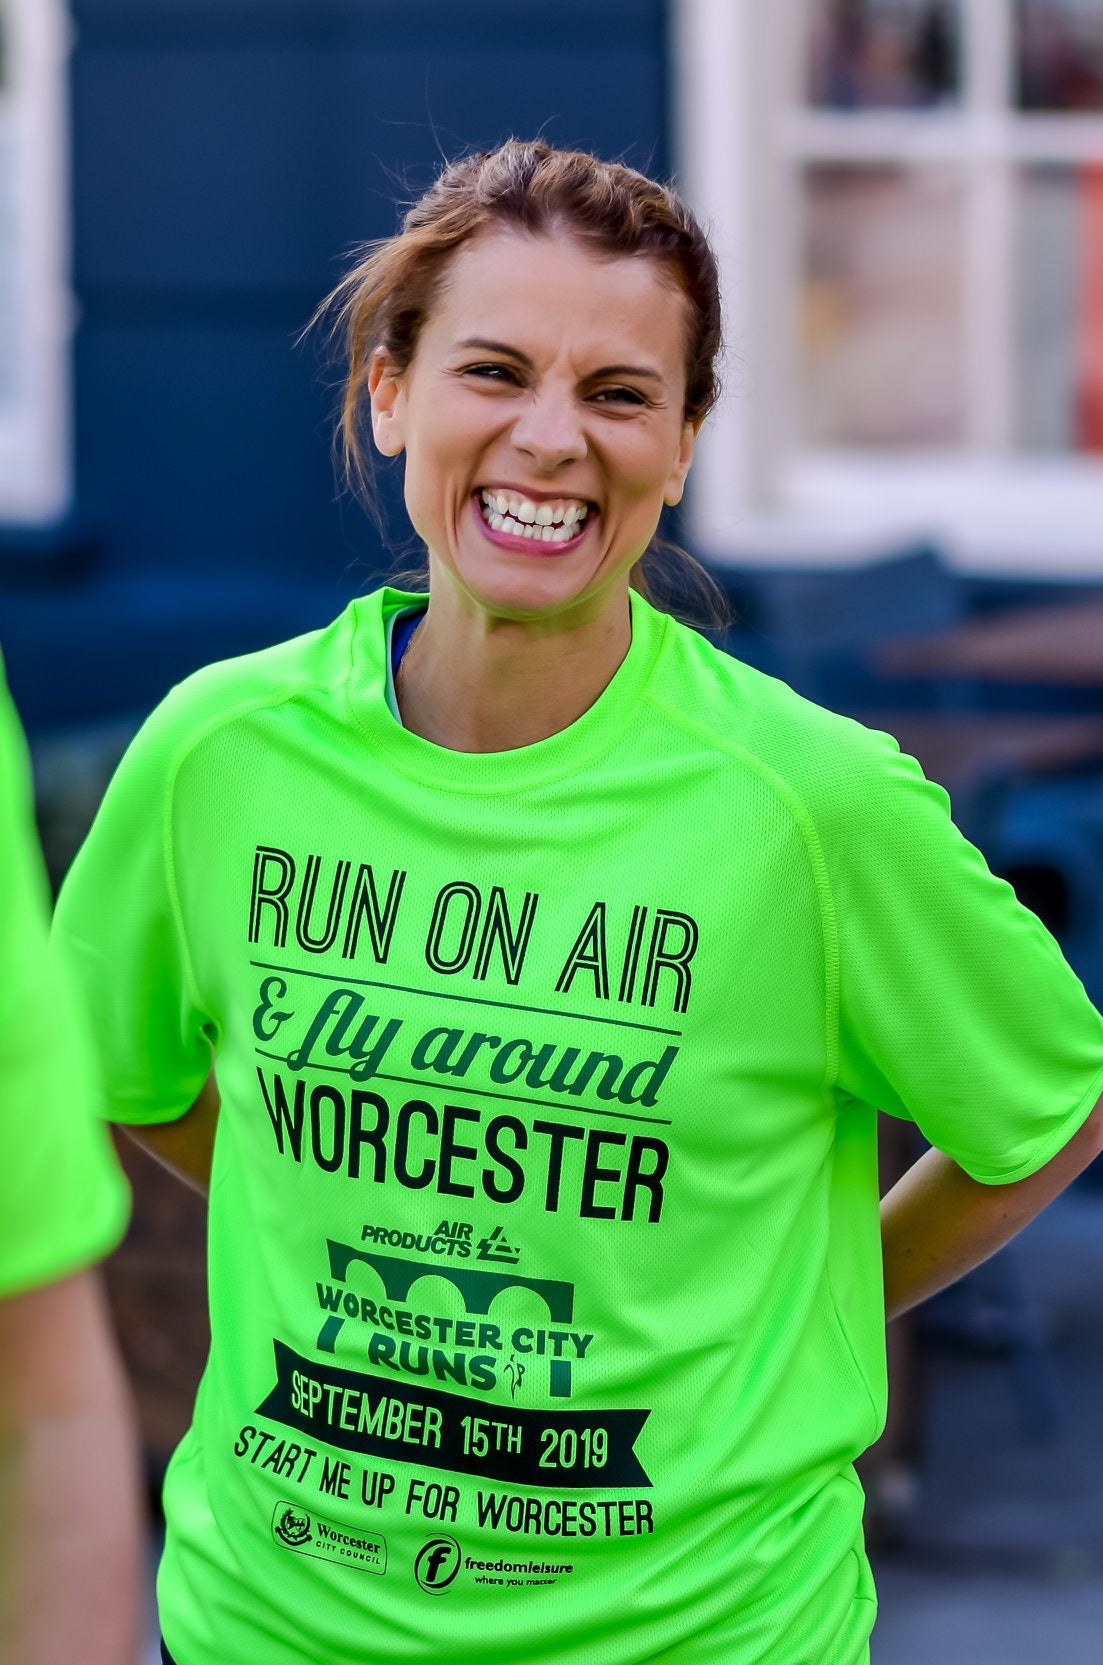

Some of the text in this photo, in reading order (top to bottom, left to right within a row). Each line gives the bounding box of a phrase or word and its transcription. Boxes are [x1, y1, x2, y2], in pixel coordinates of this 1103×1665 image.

[248, 845, 699, 1013] RUN ON AIR
[252, 976, 679, 1107] & fly around
[256, 1065, 670, 1223] WORCESTER
[361, 1224, 471, 1257] PRODUCTS
[434, 1220, 473, 1240] AIR
[316, 1282, 594, 1358] WORCESTER CITY
[368, 1333, 497, 1391] RUNS
[291, 1370, 608, 1468] SEPTEMBER 15TH 2019
[234, 1425, 654, 1537] START ME UP FOR WORCESTER
[315, 1540, 381, 1565] CITY COUNCIL
[317, 1522, 381, 1554] Worcester
[465, 1557, 573, 1574] freedomleisure
[474, 1575, 504, 1586] where
[506, 1578, 524, 1587] you
